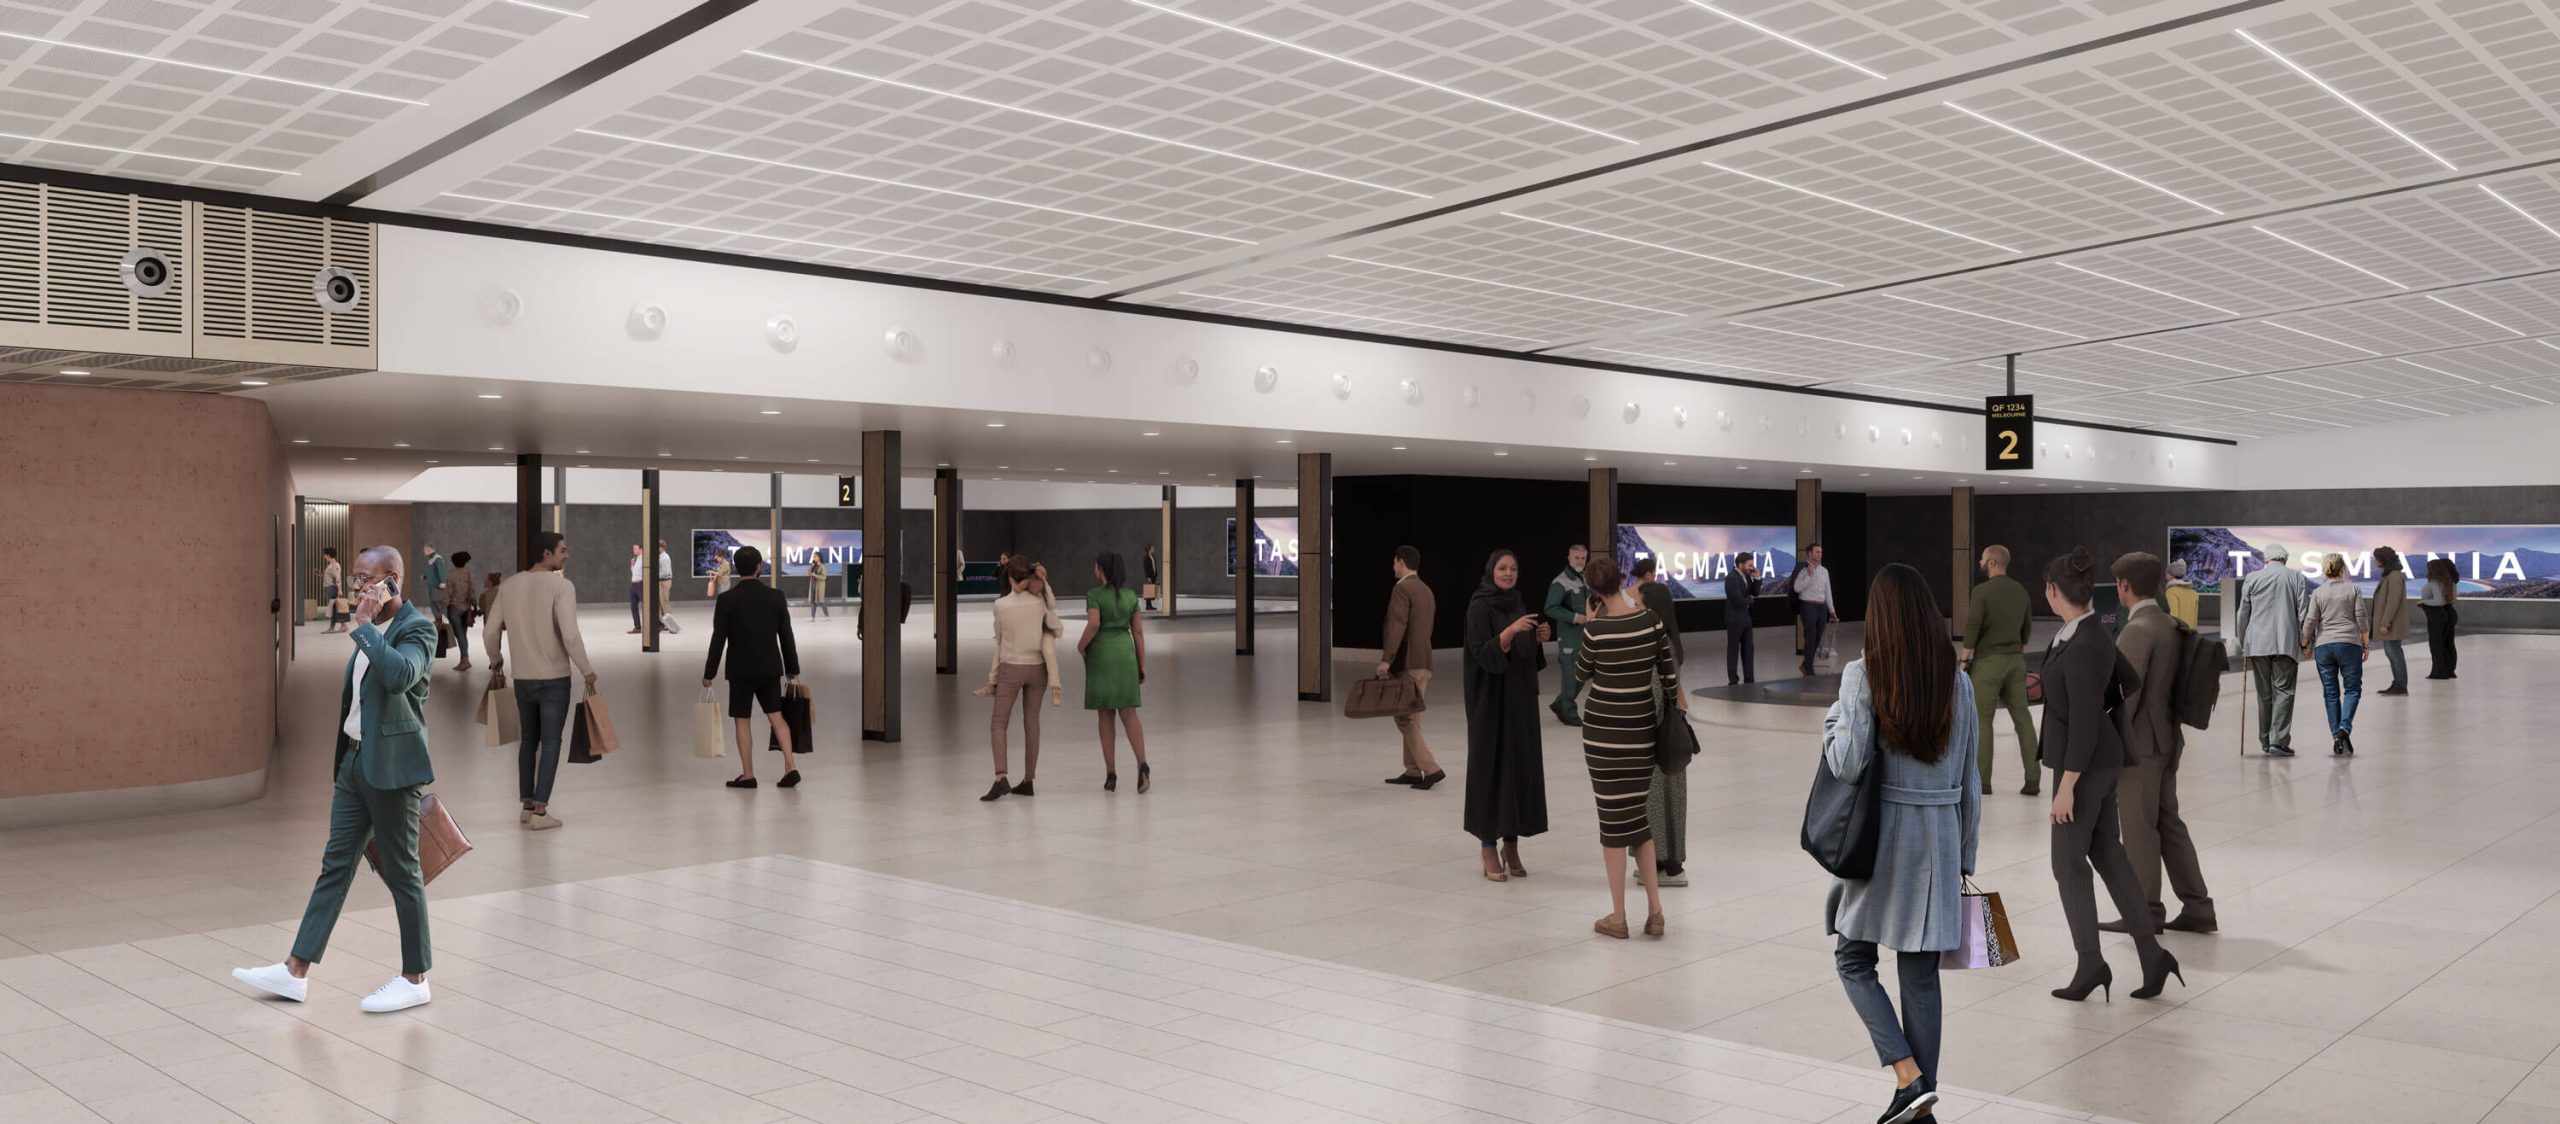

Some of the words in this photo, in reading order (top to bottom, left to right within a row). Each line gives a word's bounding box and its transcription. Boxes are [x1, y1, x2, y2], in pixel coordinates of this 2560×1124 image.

[1992, 404, 2005, 412] QF
[2006, 403, 2026, 411] 1234
[1999, 430, 2019, 460] 2
[842, 484, 850, 501] 2
